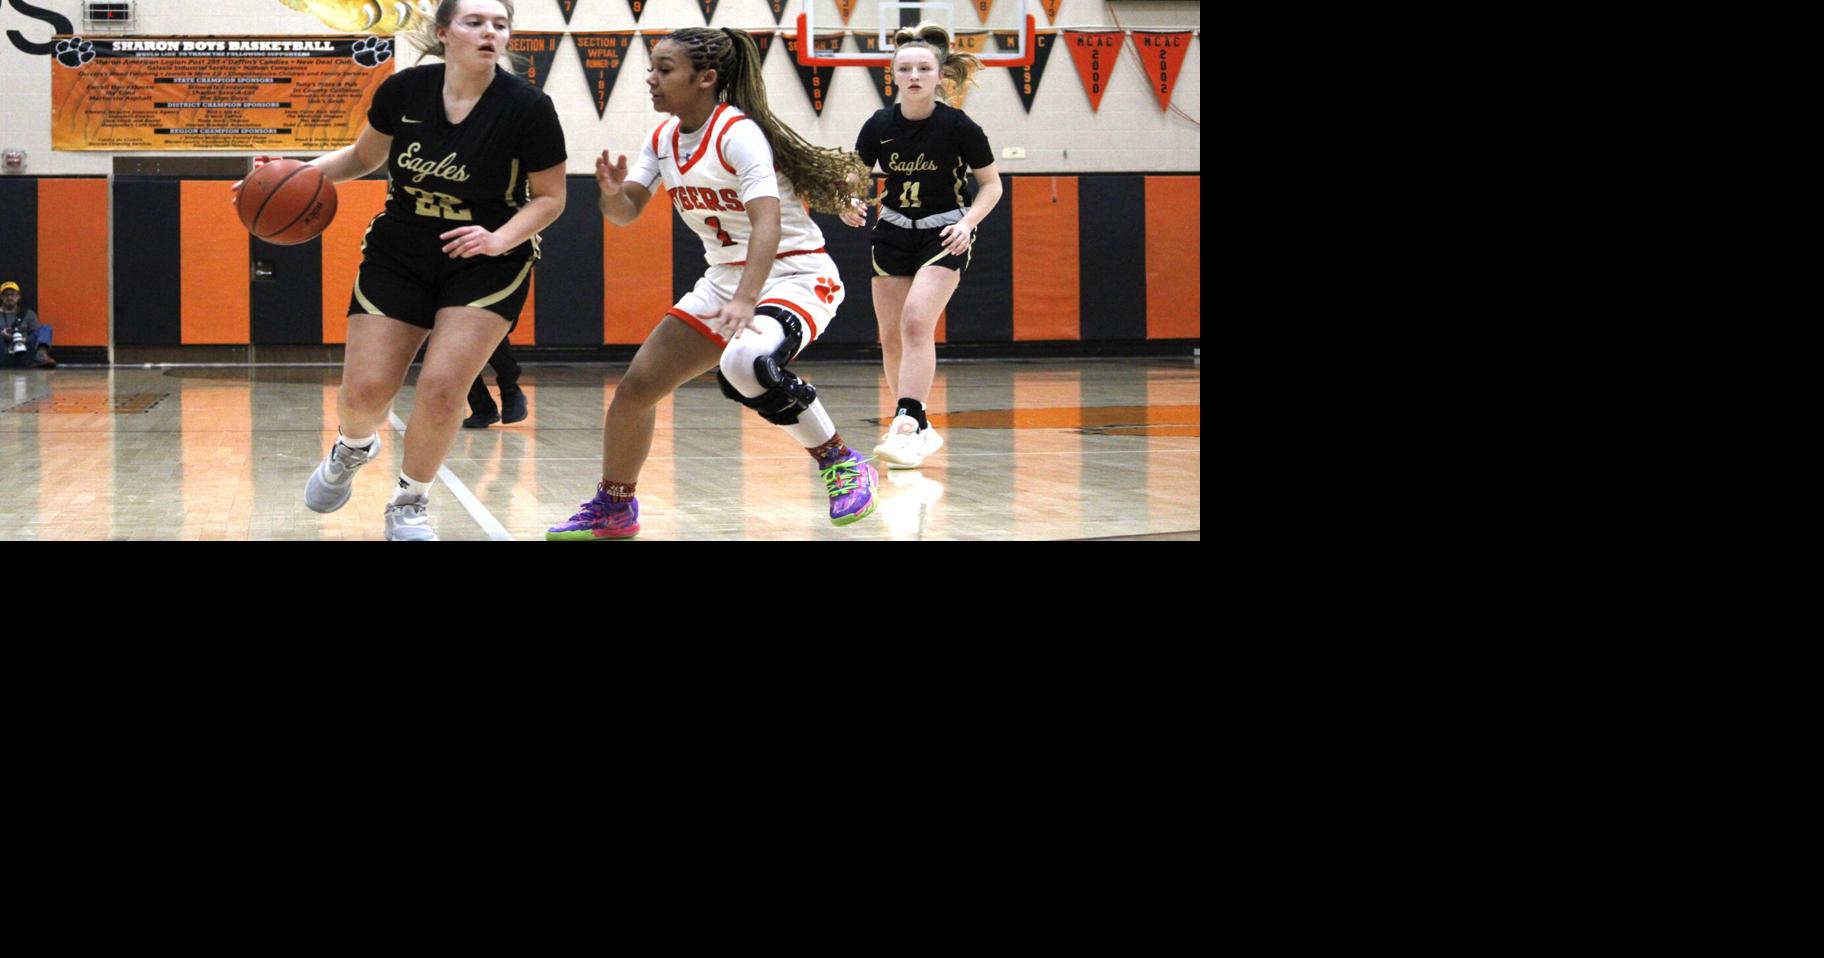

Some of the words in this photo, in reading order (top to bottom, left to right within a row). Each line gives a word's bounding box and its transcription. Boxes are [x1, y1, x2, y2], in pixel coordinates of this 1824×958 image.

[112, 41, 181, 51] SHARON
[182, 41, 226, 51] BOYS
[228, 41, 335, 51] BASKETBALL
[509, 38, 545, 51] SECTION
[577, 37, 616, 47] SECTION
[588, 49, 618, 58] WPIAL
[1091, 49, 1099, 93] 2000
[1159, 49, 1168, 93] 2002
[397, 142, 470, 183] Eagles
[889, 152, 938, 176] Eagles
[404, 186, 472, 221] 22
[900, 181, 921, 208] 11
